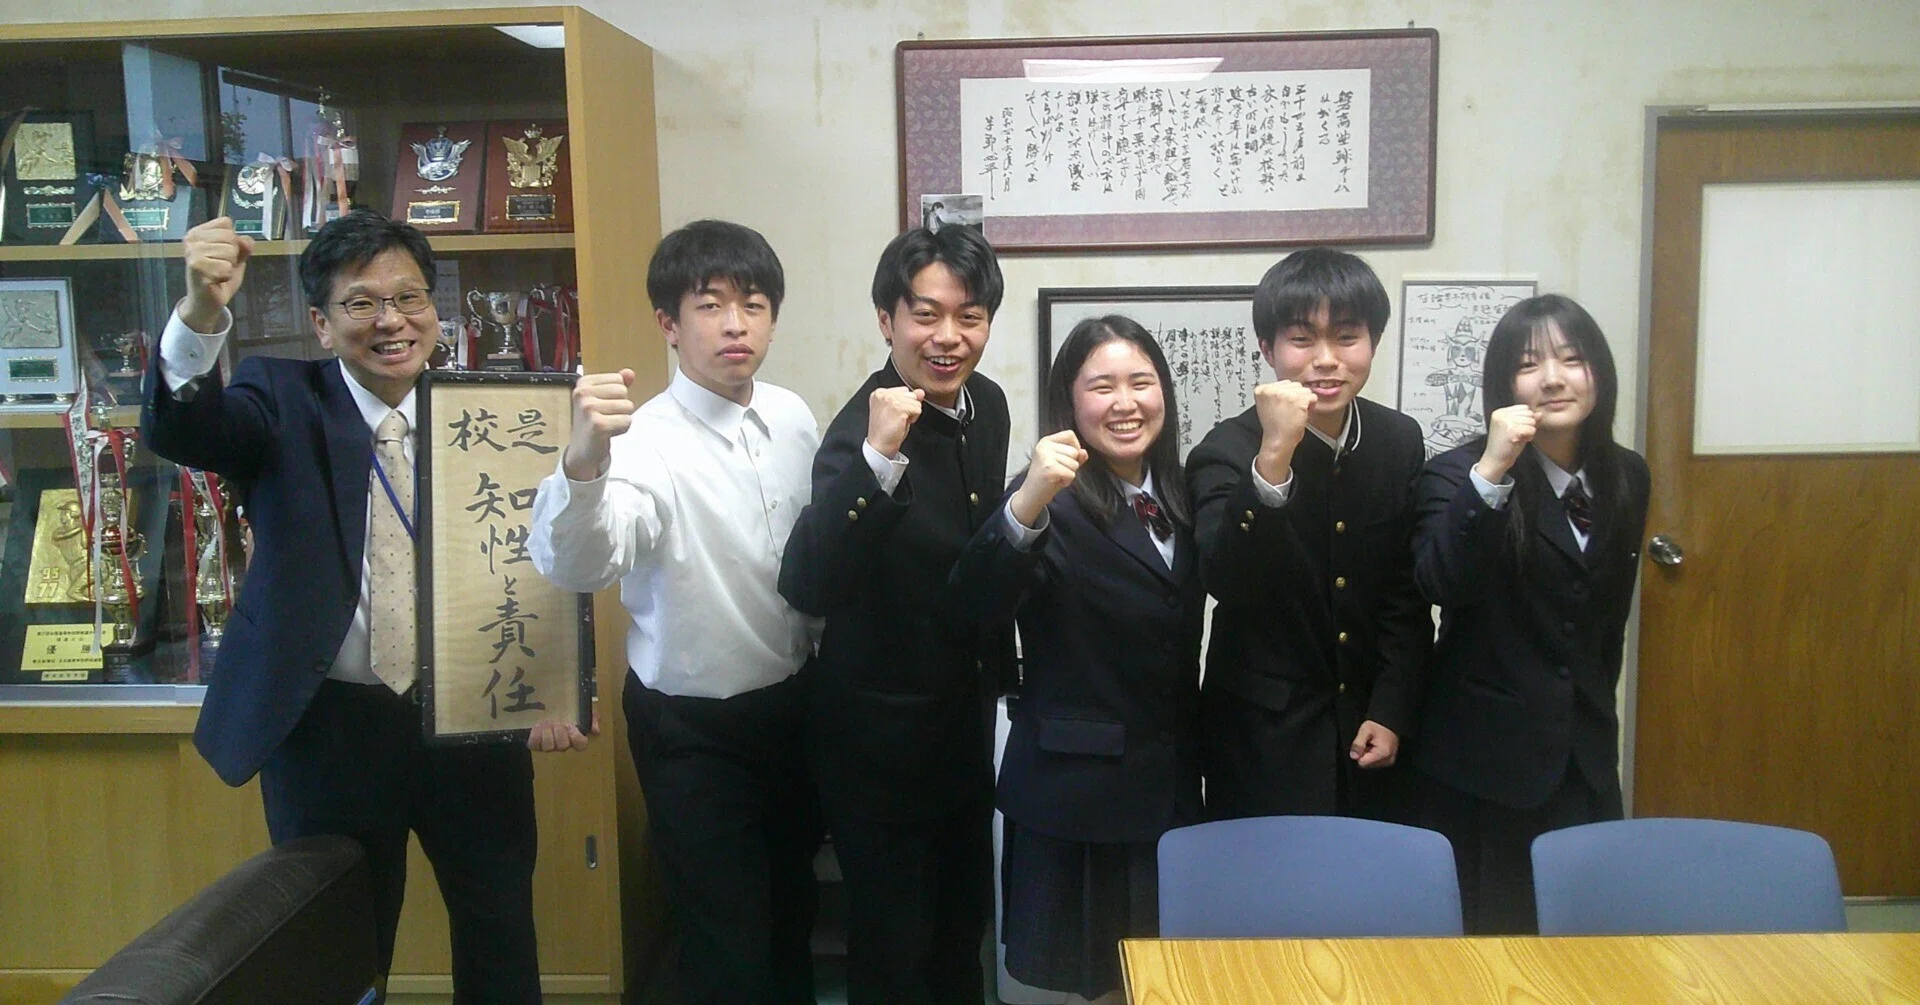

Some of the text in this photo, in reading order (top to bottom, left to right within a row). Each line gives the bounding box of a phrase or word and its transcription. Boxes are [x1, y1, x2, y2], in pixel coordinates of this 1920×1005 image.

[448, 407, 560, 454] 校是
[465, 472, 546, 719] 知性と責任
